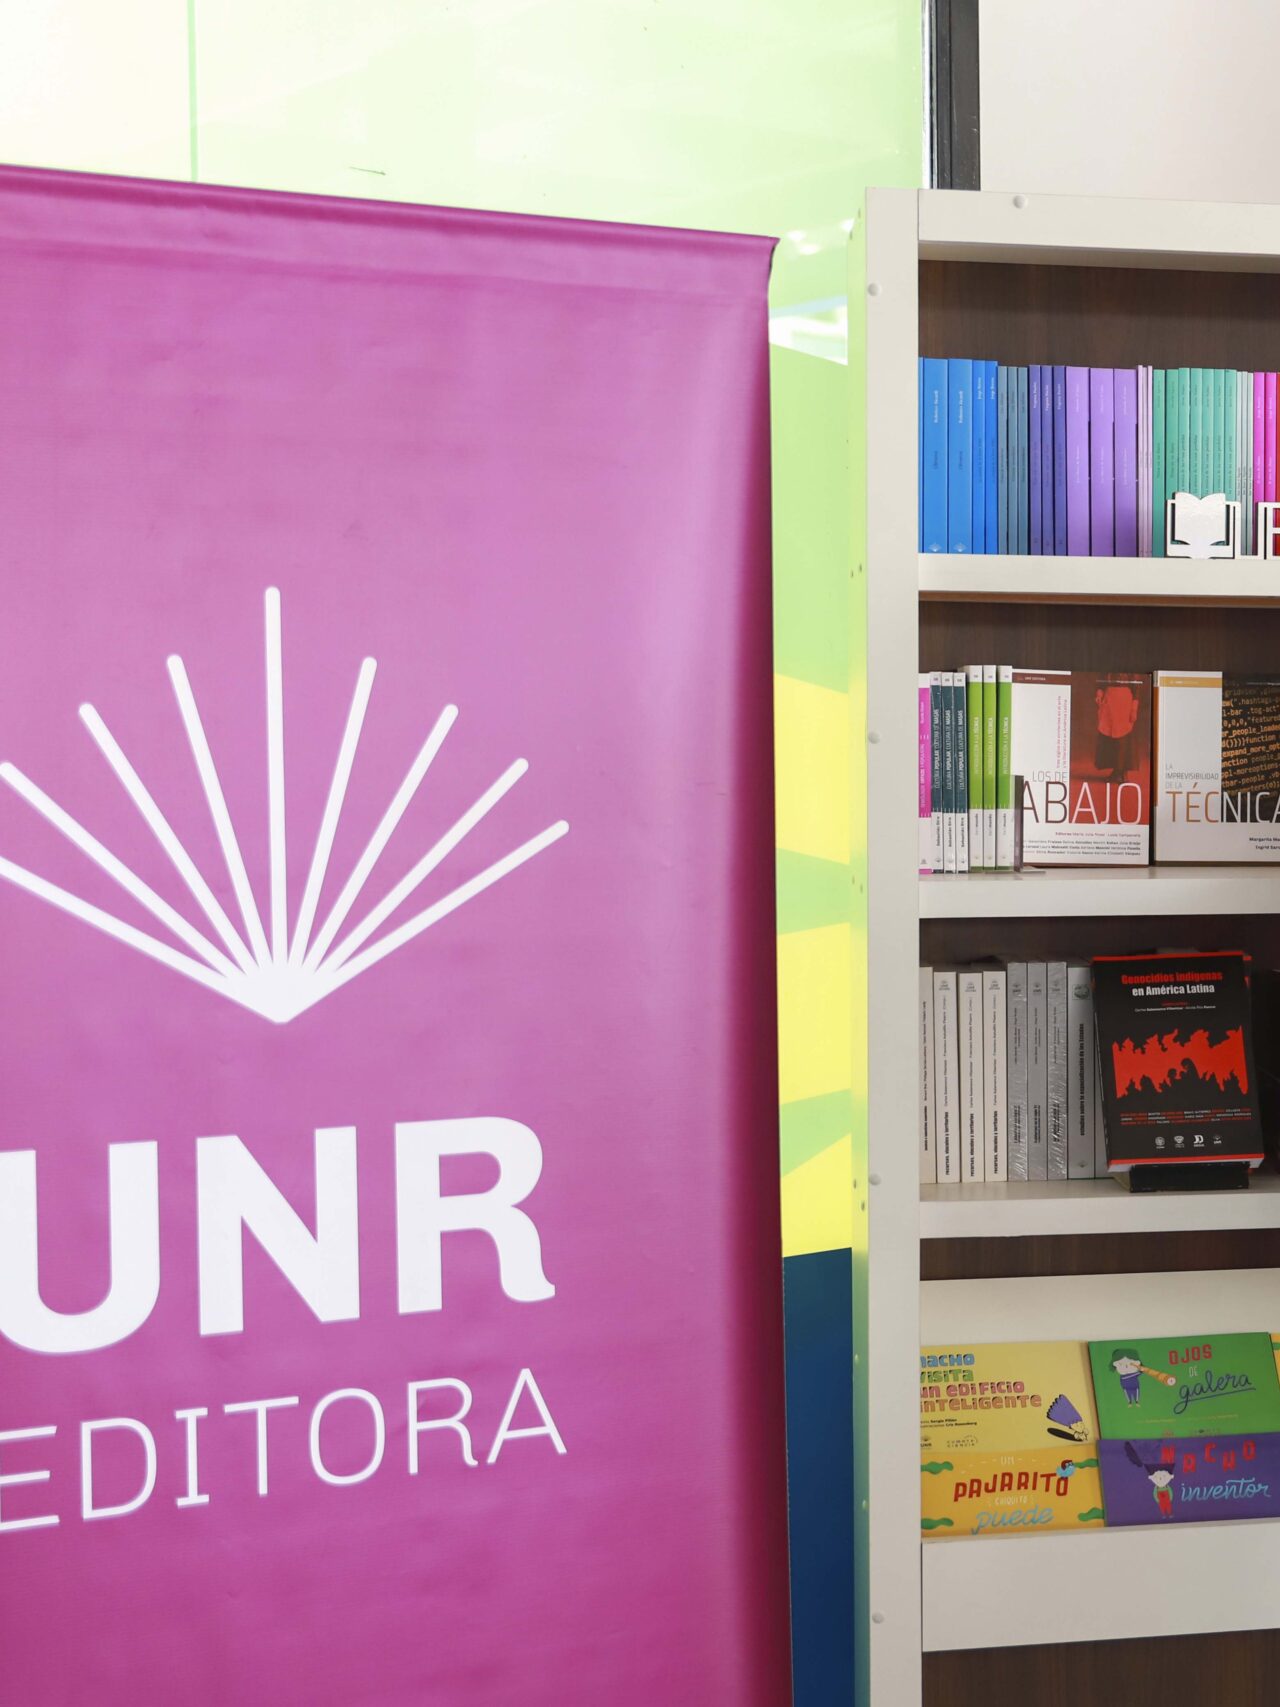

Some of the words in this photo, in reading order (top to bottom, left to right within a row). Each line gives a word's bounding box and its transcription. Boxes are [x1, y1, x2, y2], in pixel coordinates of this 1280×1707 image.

[1033, 770, 1051, 782] LOS
[1055, 771, 1068, 783] DE
[1166, 772, 1219, 780] IMPREVISIBILIDAD
[1023, 781, 1142, 825] ABAJO
[1121, 973, 1174, 985] Genocidios
[1132, 988, 1144, 996] en
[1146, 985, 1185, 996] América
[1186, 984, 1215, 993] Latina
[0, 1116, 556, 1355] UNR
[1168, 1344, 1212, 1365] OJOS
[1189, 1366, 1198, 1377] DE
[1173, 1370, 1254, 1414] galera
[0, 1367, 567, 1533] EDITORA
[953, 1471, 1069, 1502] PAJARITO
[1181, 1477, 1272, 1502] inventor
[970, 1504, 1055, 1535] puede
